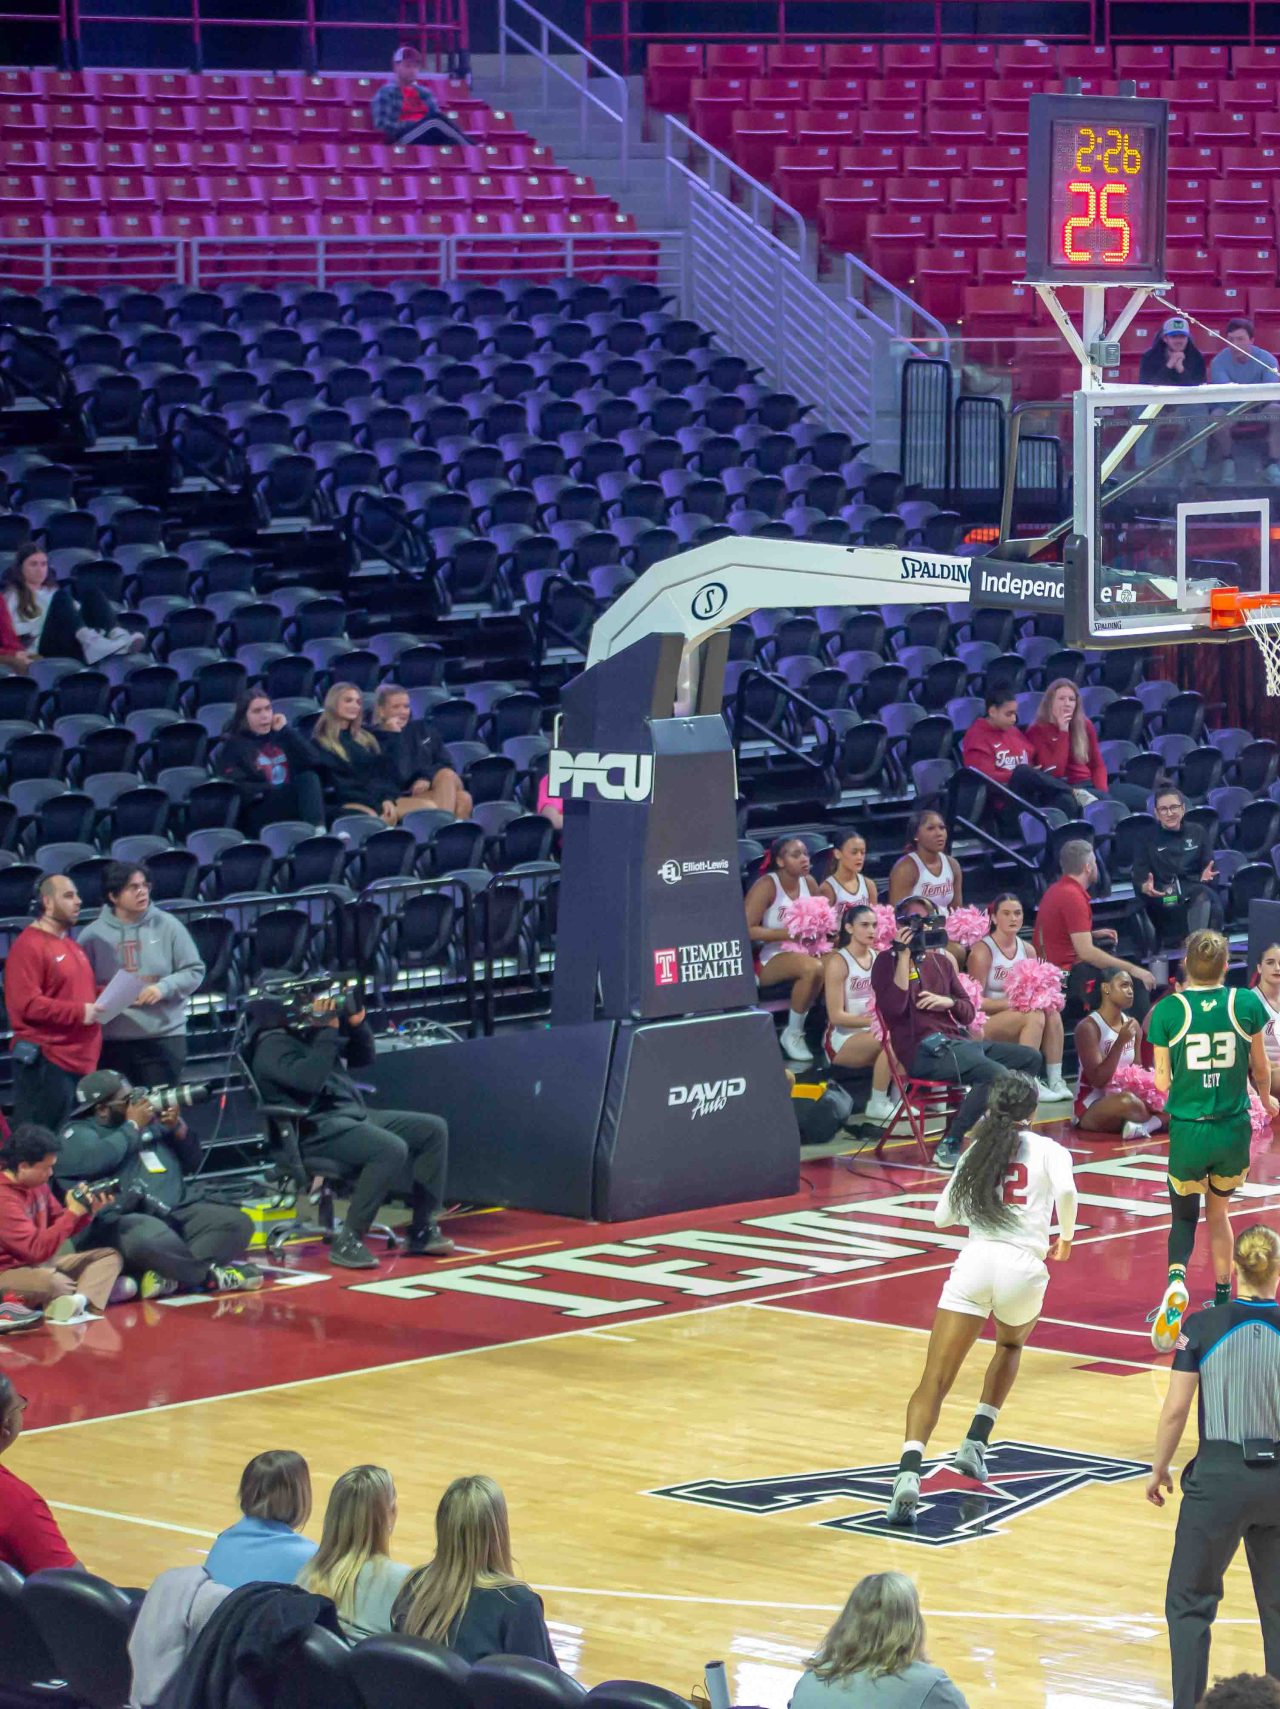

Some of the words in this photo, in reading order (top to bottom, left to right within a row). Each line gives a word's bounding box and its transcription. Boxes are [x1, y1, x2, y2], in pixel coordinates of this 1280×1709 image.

[1075, 127, 1141, 175] 2:26
[1064, 182, 1130, 262] 25
[901, 557, 970, 583] SPALDIN
[1094, 620, 1121, 632] SPALDING
[548, 750, 653, 801] PFCU
[682, 860, 729, 873] Elliott-Lewis
[679, 940, 741, 964] TEMPLE
[681, 958, 743, 983] HEALTH
[1185, 1031, 1236, 1070] 23
[668, 1077, 747, 1106] DAVID
[1203, 1073, 1221, 1088] LEVY
[691, 1096, 728, 1120] Auto
[1002, 1162, 1028, 1205] 2
